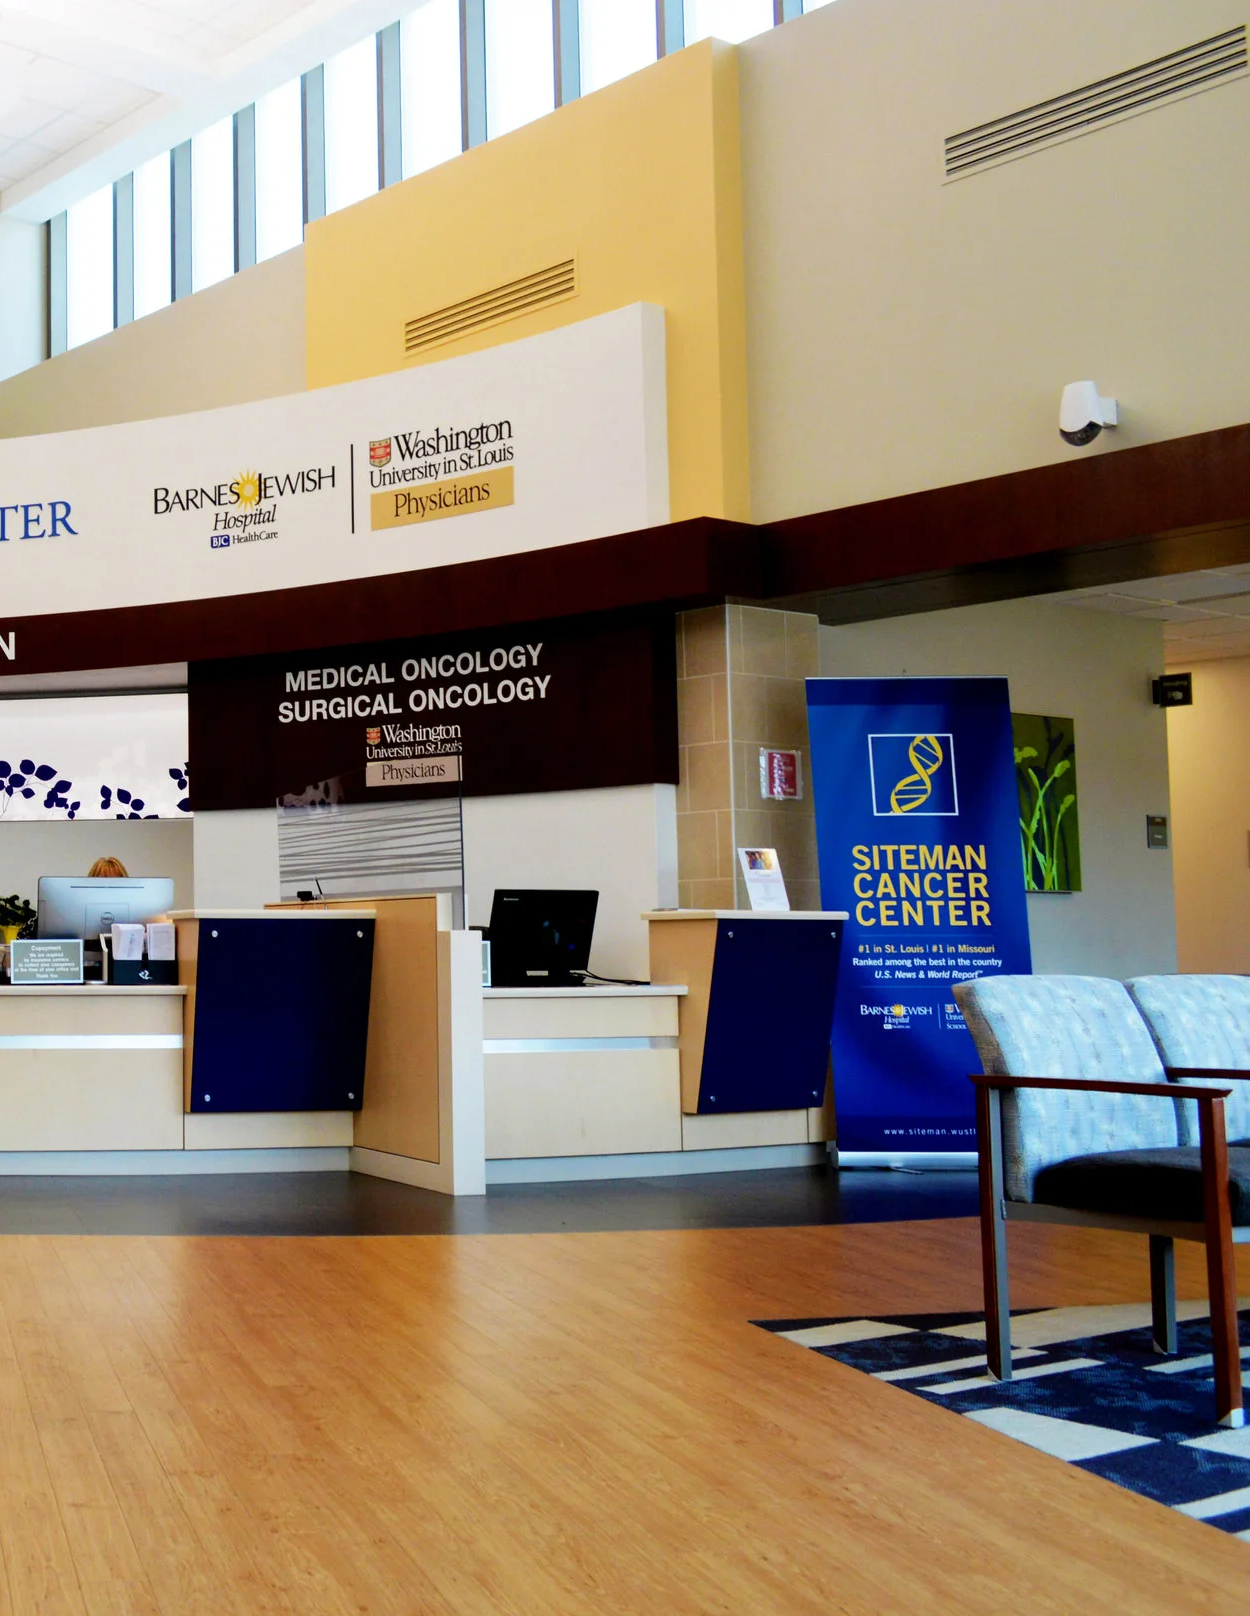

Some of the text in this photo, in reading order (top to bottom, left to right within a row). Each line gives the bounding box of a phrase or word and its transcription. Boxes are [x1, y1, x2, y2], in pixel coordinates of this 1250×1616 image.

[395, 420, 513, 461] Washington
[369, 463, 441, 489] University
[443, 457, 457, 474] in
[153, 465, 336, 515] BARNES JEWISH
[394, 482, 490, 518] Physicians
[213, 504, 277, 533] Hospital
[212, 531, 279, 548] BJC HealthCare
[286, 643, 543, 692] MEDICAL ONCOLOGY
[278, 675, 552, 723] SURGICAL ONCOLOGY
[382, 723, 462, 743] Washington
[366, 744, 414, 759] University
[414, 743, 425, 755] in
[382, 763, 446, 782] Physicians
[852, 844, 987, 871] SITEMAN
[853, 872, 990, 898] CANCER
[855, 900, 992, 927] CENTER
[858, 944, 995, 953] #1 in St. Louis #1 in Missouri
[852, 957, 1002, 967] Ranked among the best in the country
[874, 970, 892, 979] U.S.
[894, 970, 916, 979] News
[918, 970, 926, 979] &
[927, 970, 950, 979] World
[860, 1004, 894, 1015] BARNES
[945, 1013, 964, 1021] Univer
[883, 1127, 976, 1136] www.siteman.wustl
